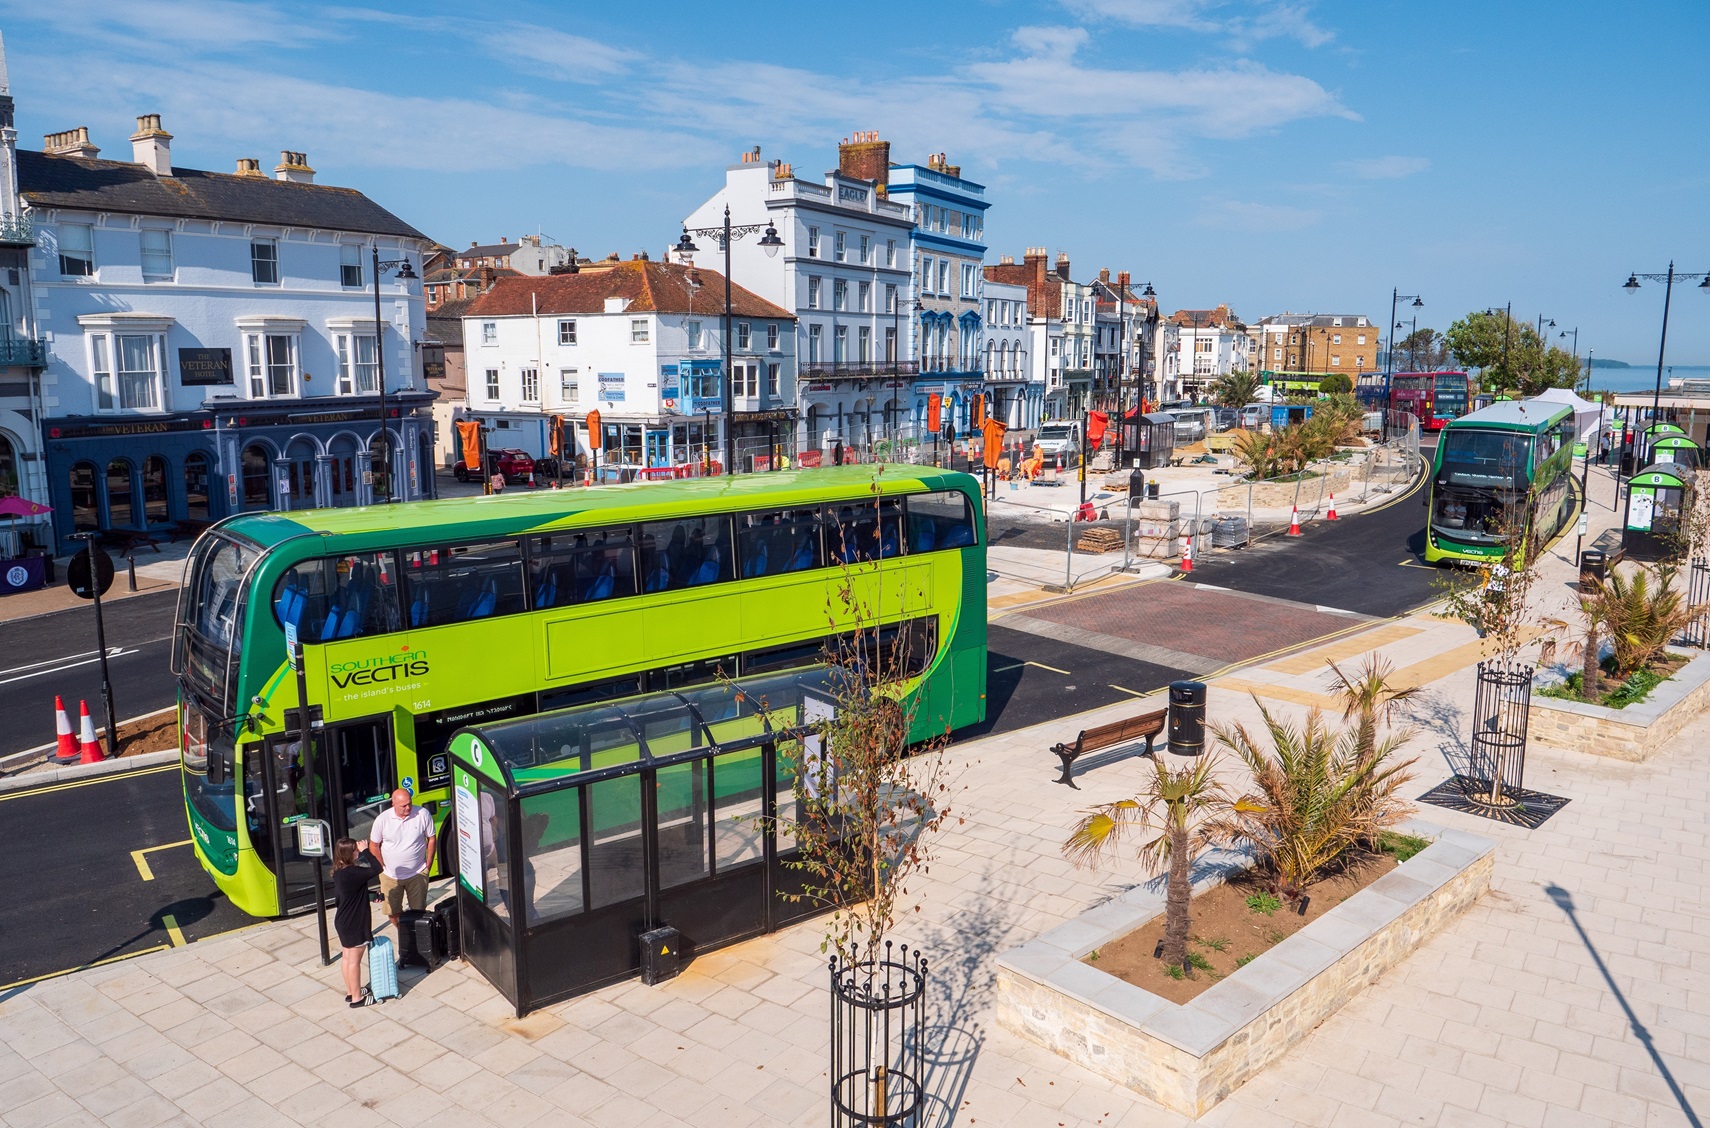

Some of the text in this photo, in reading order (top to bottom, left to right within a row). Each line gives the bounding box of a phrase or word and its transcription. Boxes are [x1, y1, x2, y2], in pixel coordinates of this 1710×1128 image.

[839, 187, 865, 202] EAGLE
[181, 360, 228, 370] VETERAN
[308, 413, 347, 422] VETERAN
[114, 422, 168, 434] VETERAN
[331, 650, 427, 673] SOUTHERN
[331, 661, 430, 689] VECTIS
[344, 682, 421, 701] the island's buses
[413, 699, 432, 710] 1614
[473, 743, 479, 763] C
